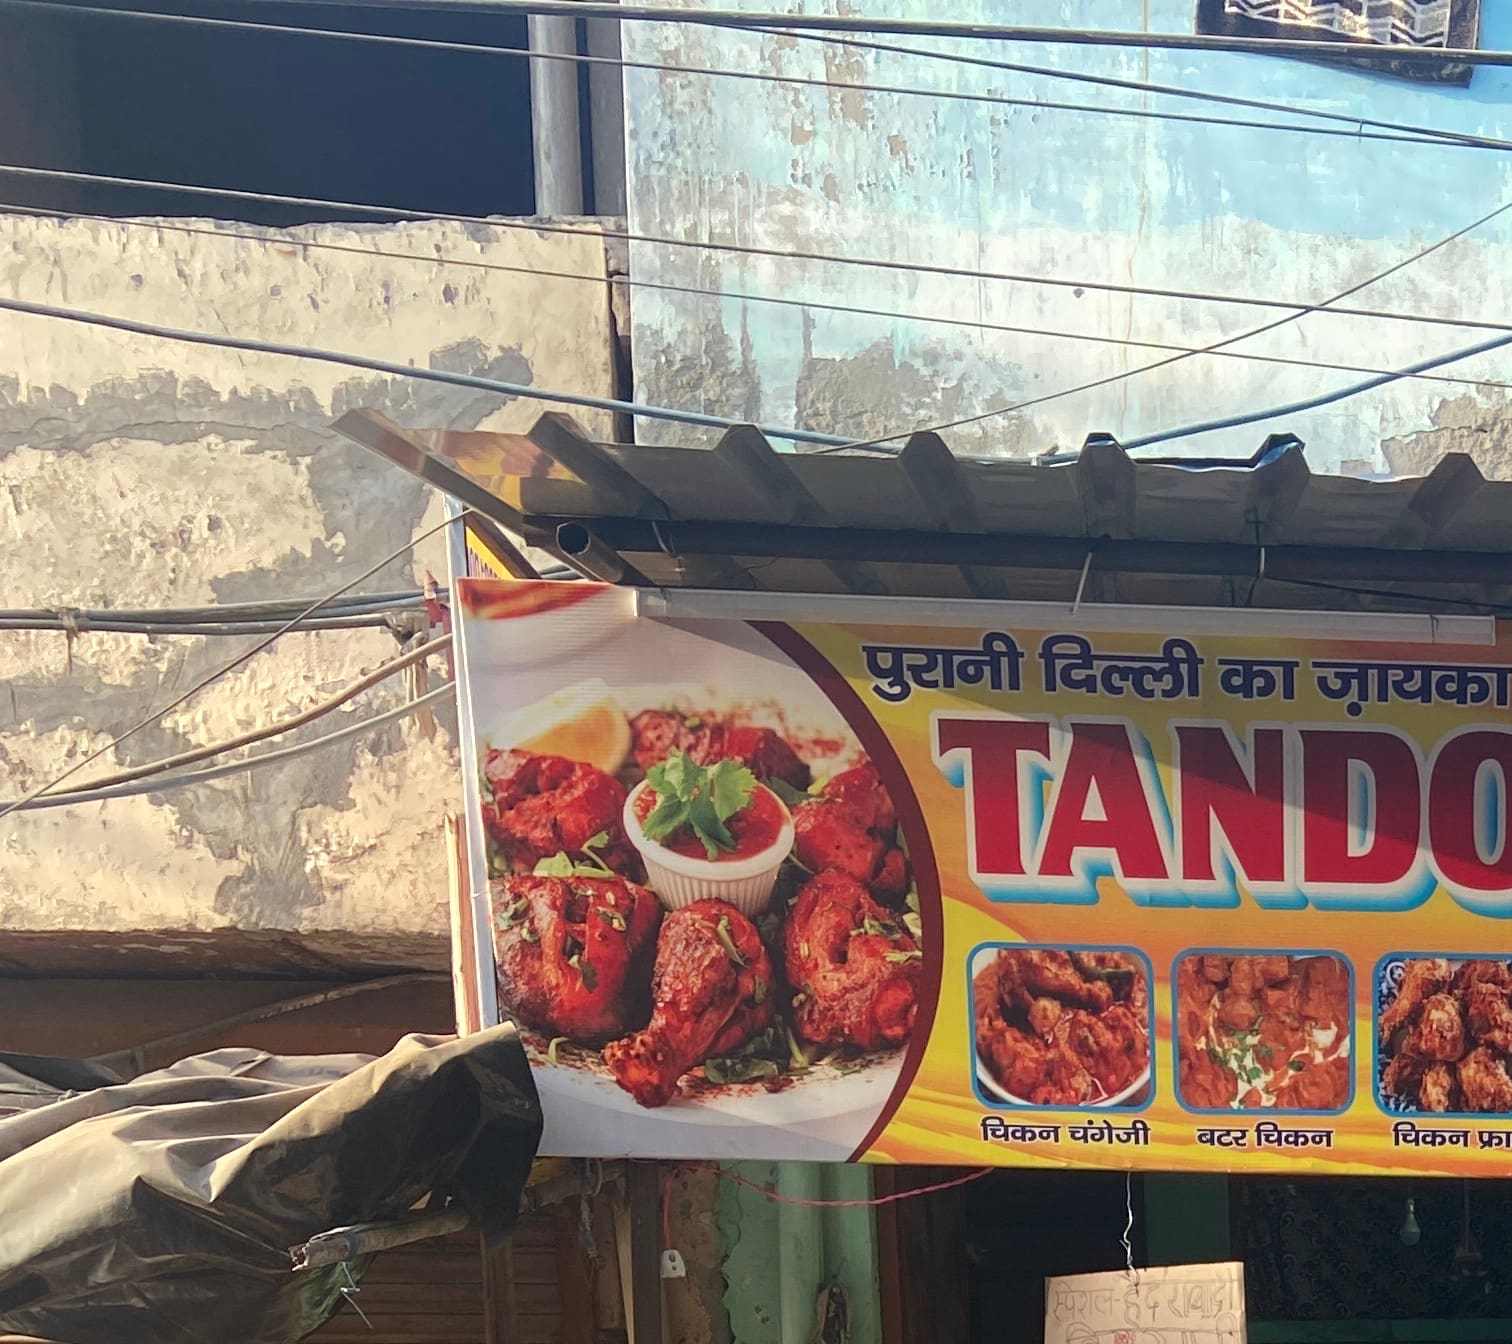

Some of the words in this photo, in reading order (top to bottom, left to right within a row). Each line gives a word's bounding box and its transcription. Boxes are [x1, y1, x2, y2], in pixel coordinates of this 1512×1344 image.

[862, 632, 1023, 700] पुरानी
[1039, 636, 1203, 698] दिल्ली
[1219, 657, 1301, 699] का
[1312, 660, 1512, 717] ज़ायका
[981, 1115, 1060, 1144] चिकन
[1197, 1125, 1248, 1149] बटर
[1254, 1119, 1332, 1149] चिकन
[1393, 1121, 1470, 1150] चिकन
